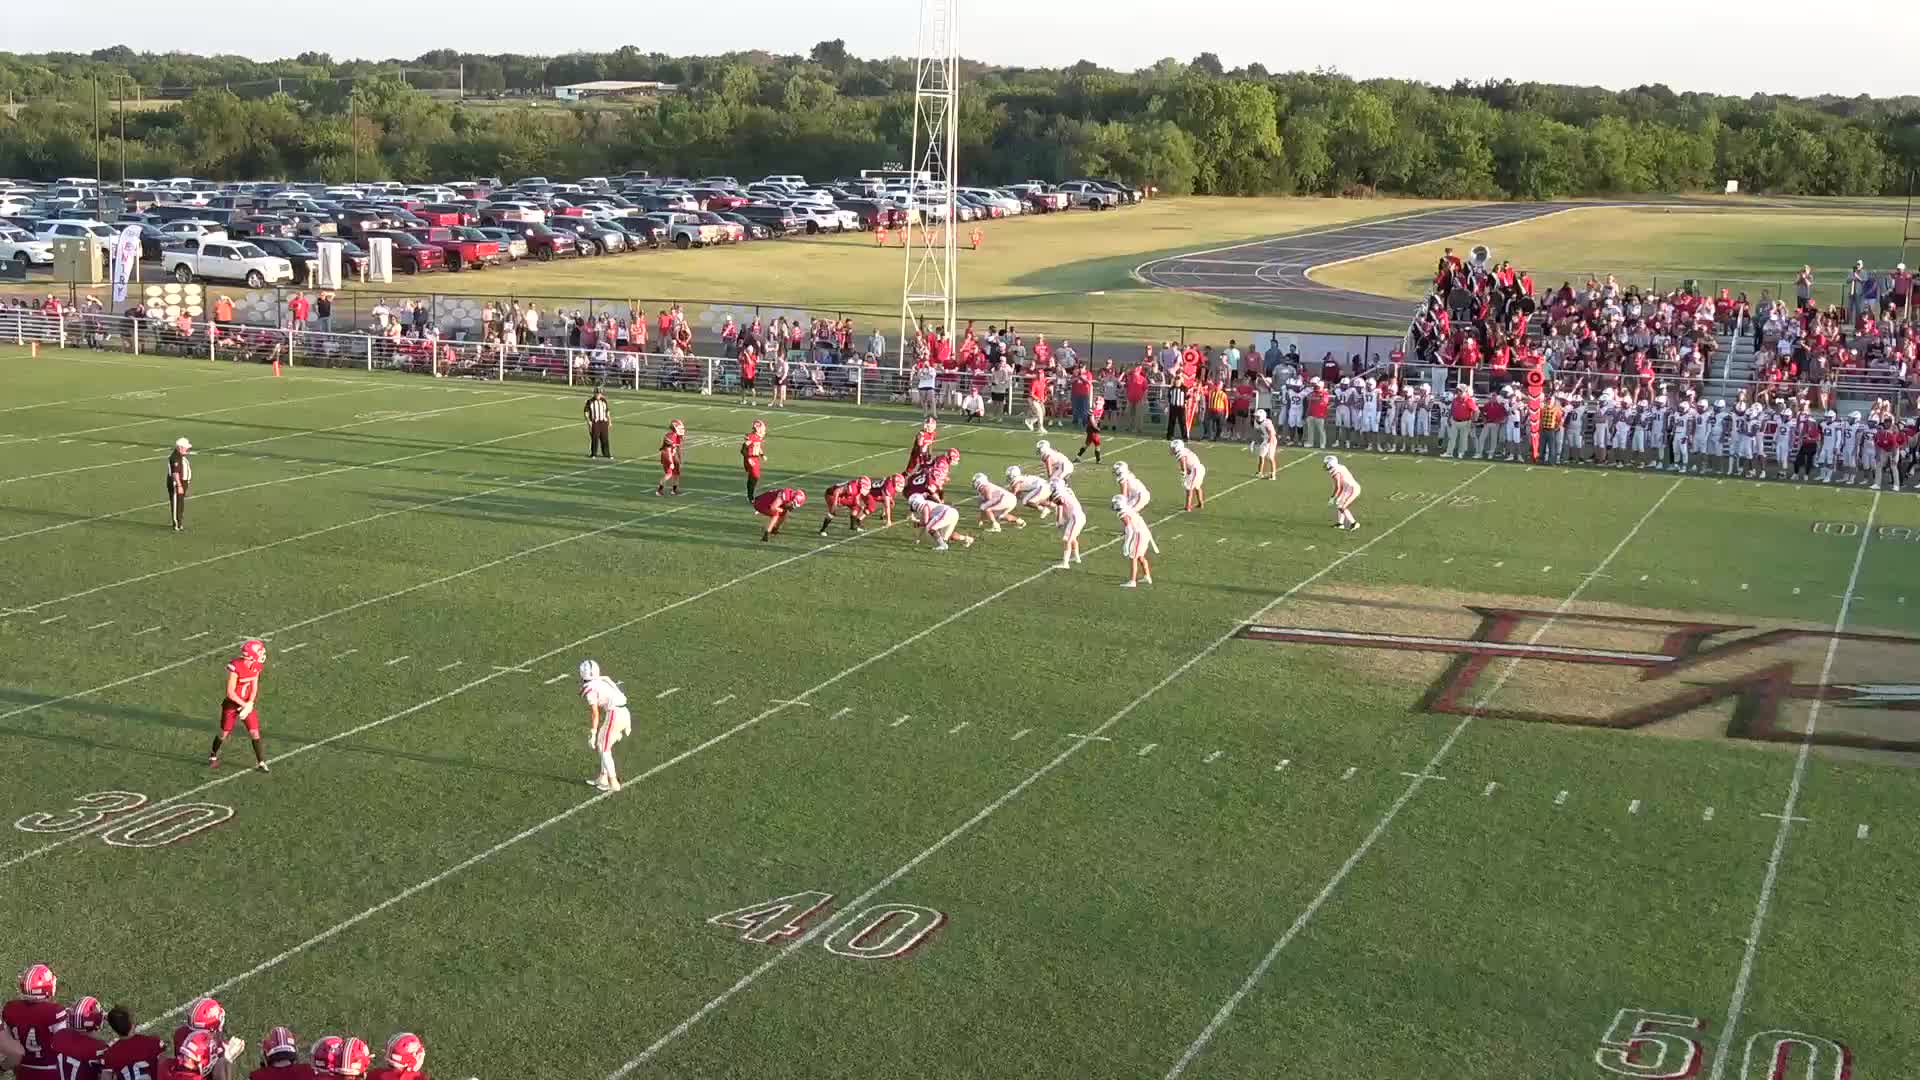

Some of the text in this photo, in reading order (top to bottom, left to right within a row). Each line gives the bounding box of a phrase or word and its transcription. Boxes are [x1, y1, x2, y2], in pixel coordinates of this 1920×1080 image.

[14, 790, 236, 848] 30
[706, 889, 949, 959] 40
[1596, 1008, 1853, 1080] 50
